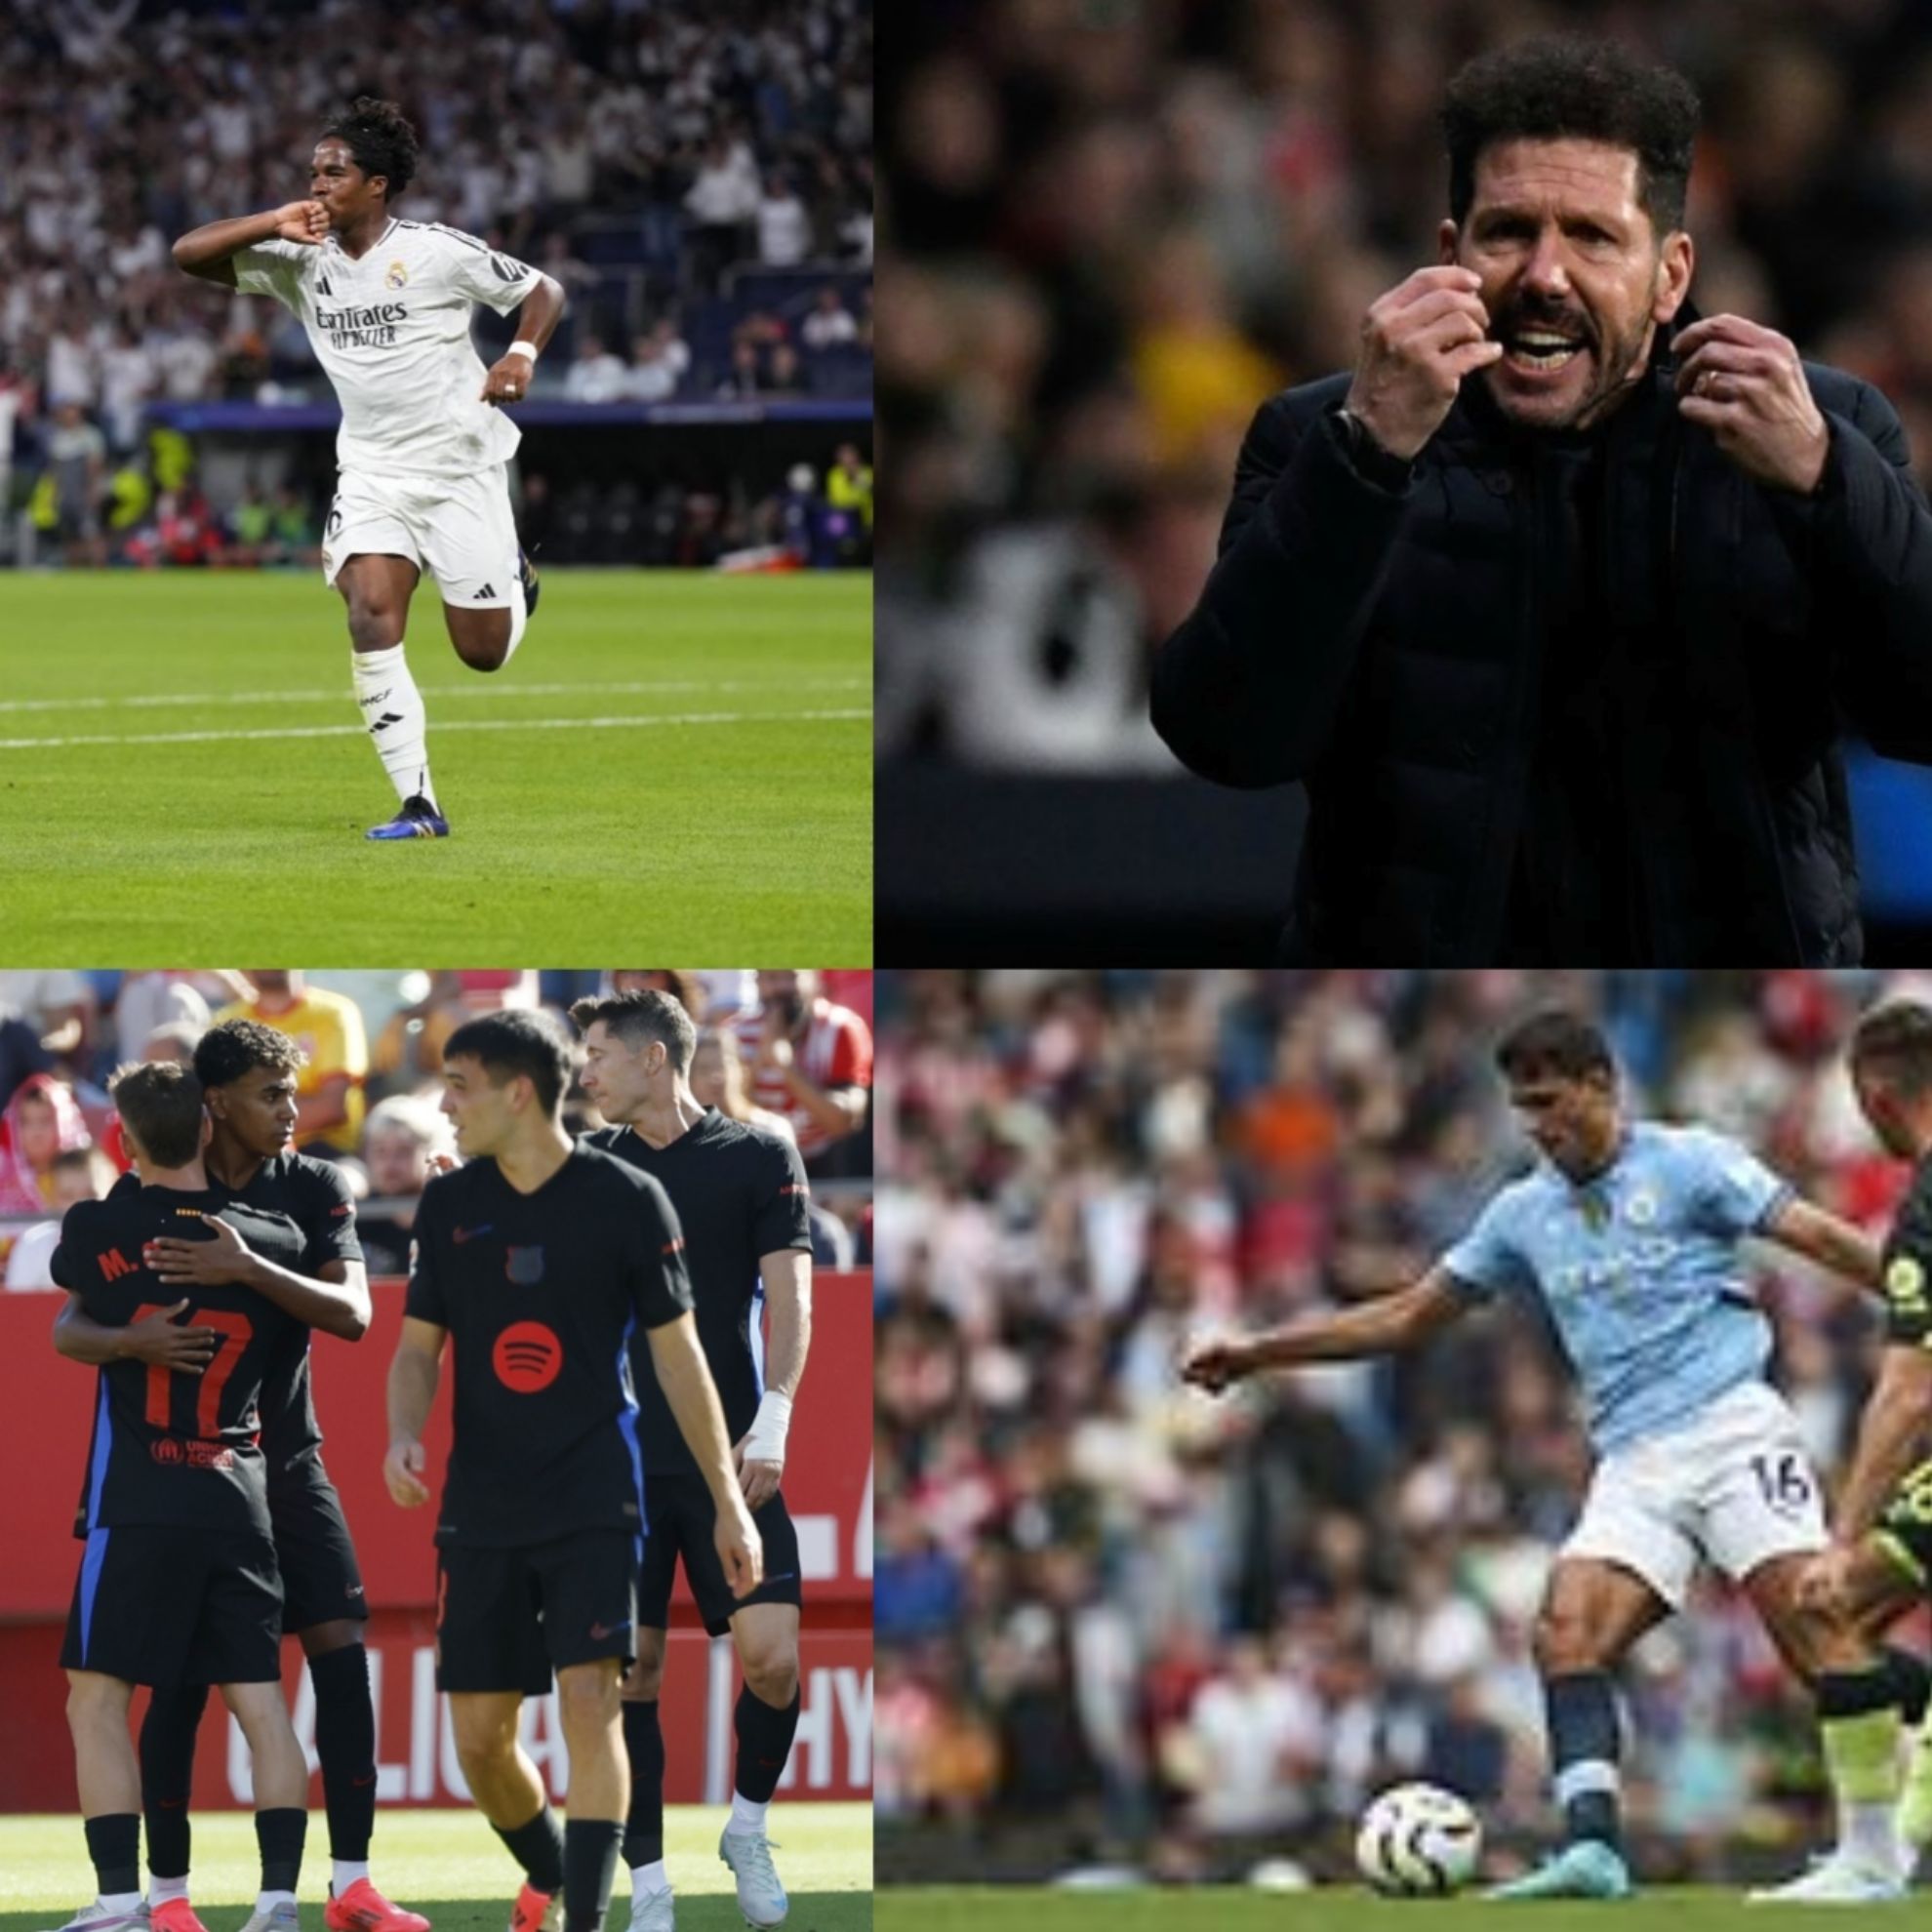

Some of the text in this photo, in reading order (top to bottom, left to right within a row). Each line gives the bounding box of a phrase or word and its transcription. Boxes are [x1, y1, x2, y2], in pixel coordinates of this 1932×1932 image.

[315, 302, 408, 330] Emirates
[98, 1247, 140, 1282] M.
[128, 1303, 254, 1438] 17
[1750, 1454, 1810, 1506] 16
